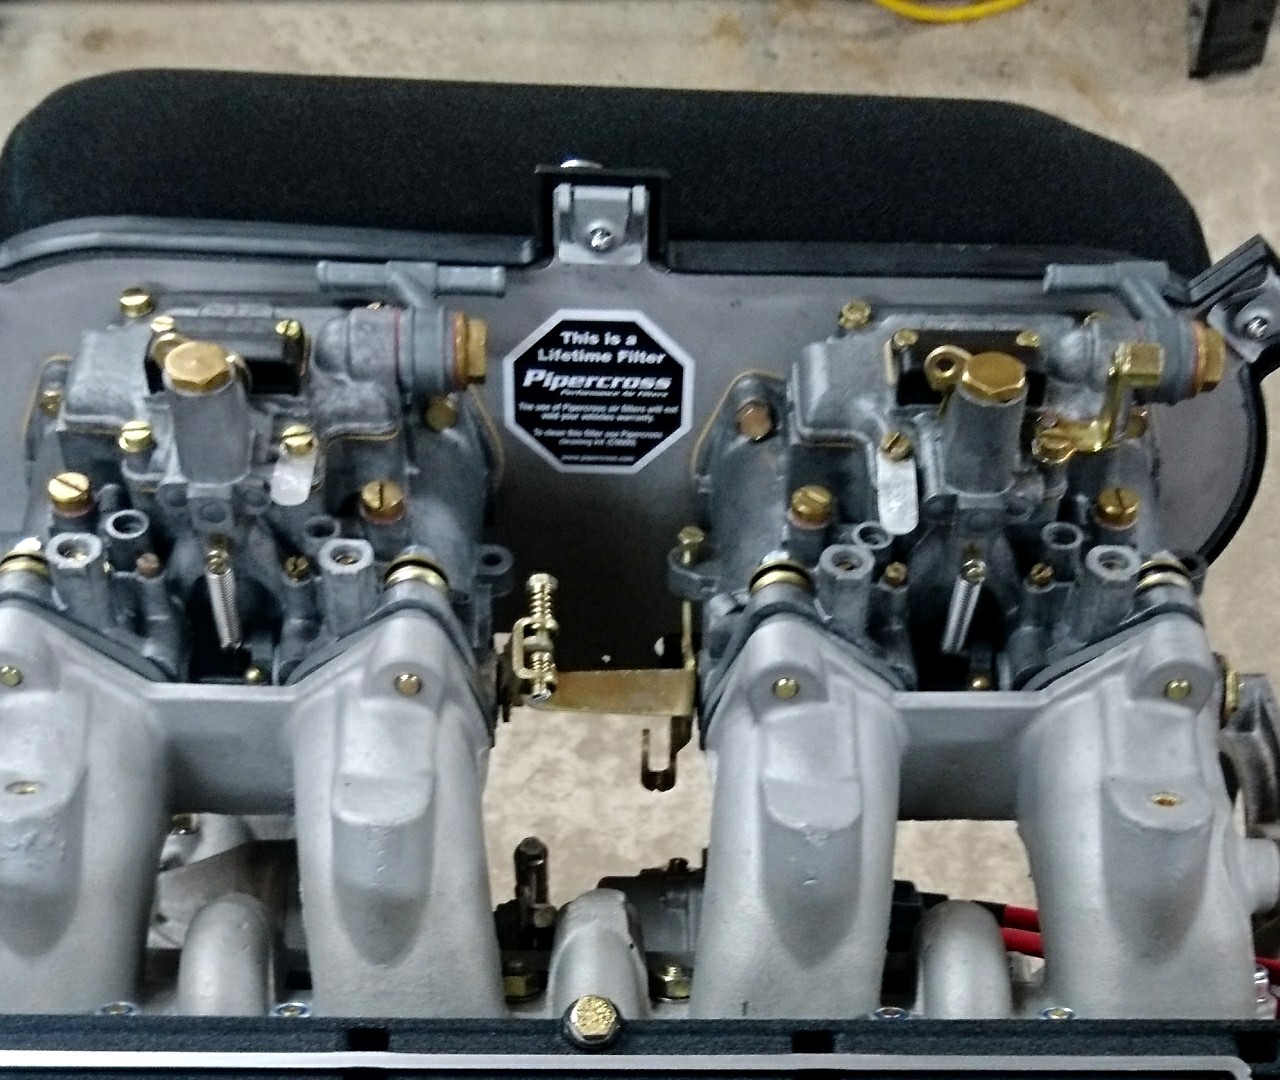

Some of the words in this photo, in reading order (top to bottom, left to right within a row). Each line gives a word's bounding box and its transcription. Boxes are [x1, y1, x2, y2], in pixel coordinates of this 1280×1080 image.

[560, 330, 600, 345] This
[604, 331, 621, 346] is
[625, 334, 638, 346] a
[537, 348, 613, 363] Lifetime
[616, 349, 667, 364] Filter
[522, 368, 673, 392] Pipercross
